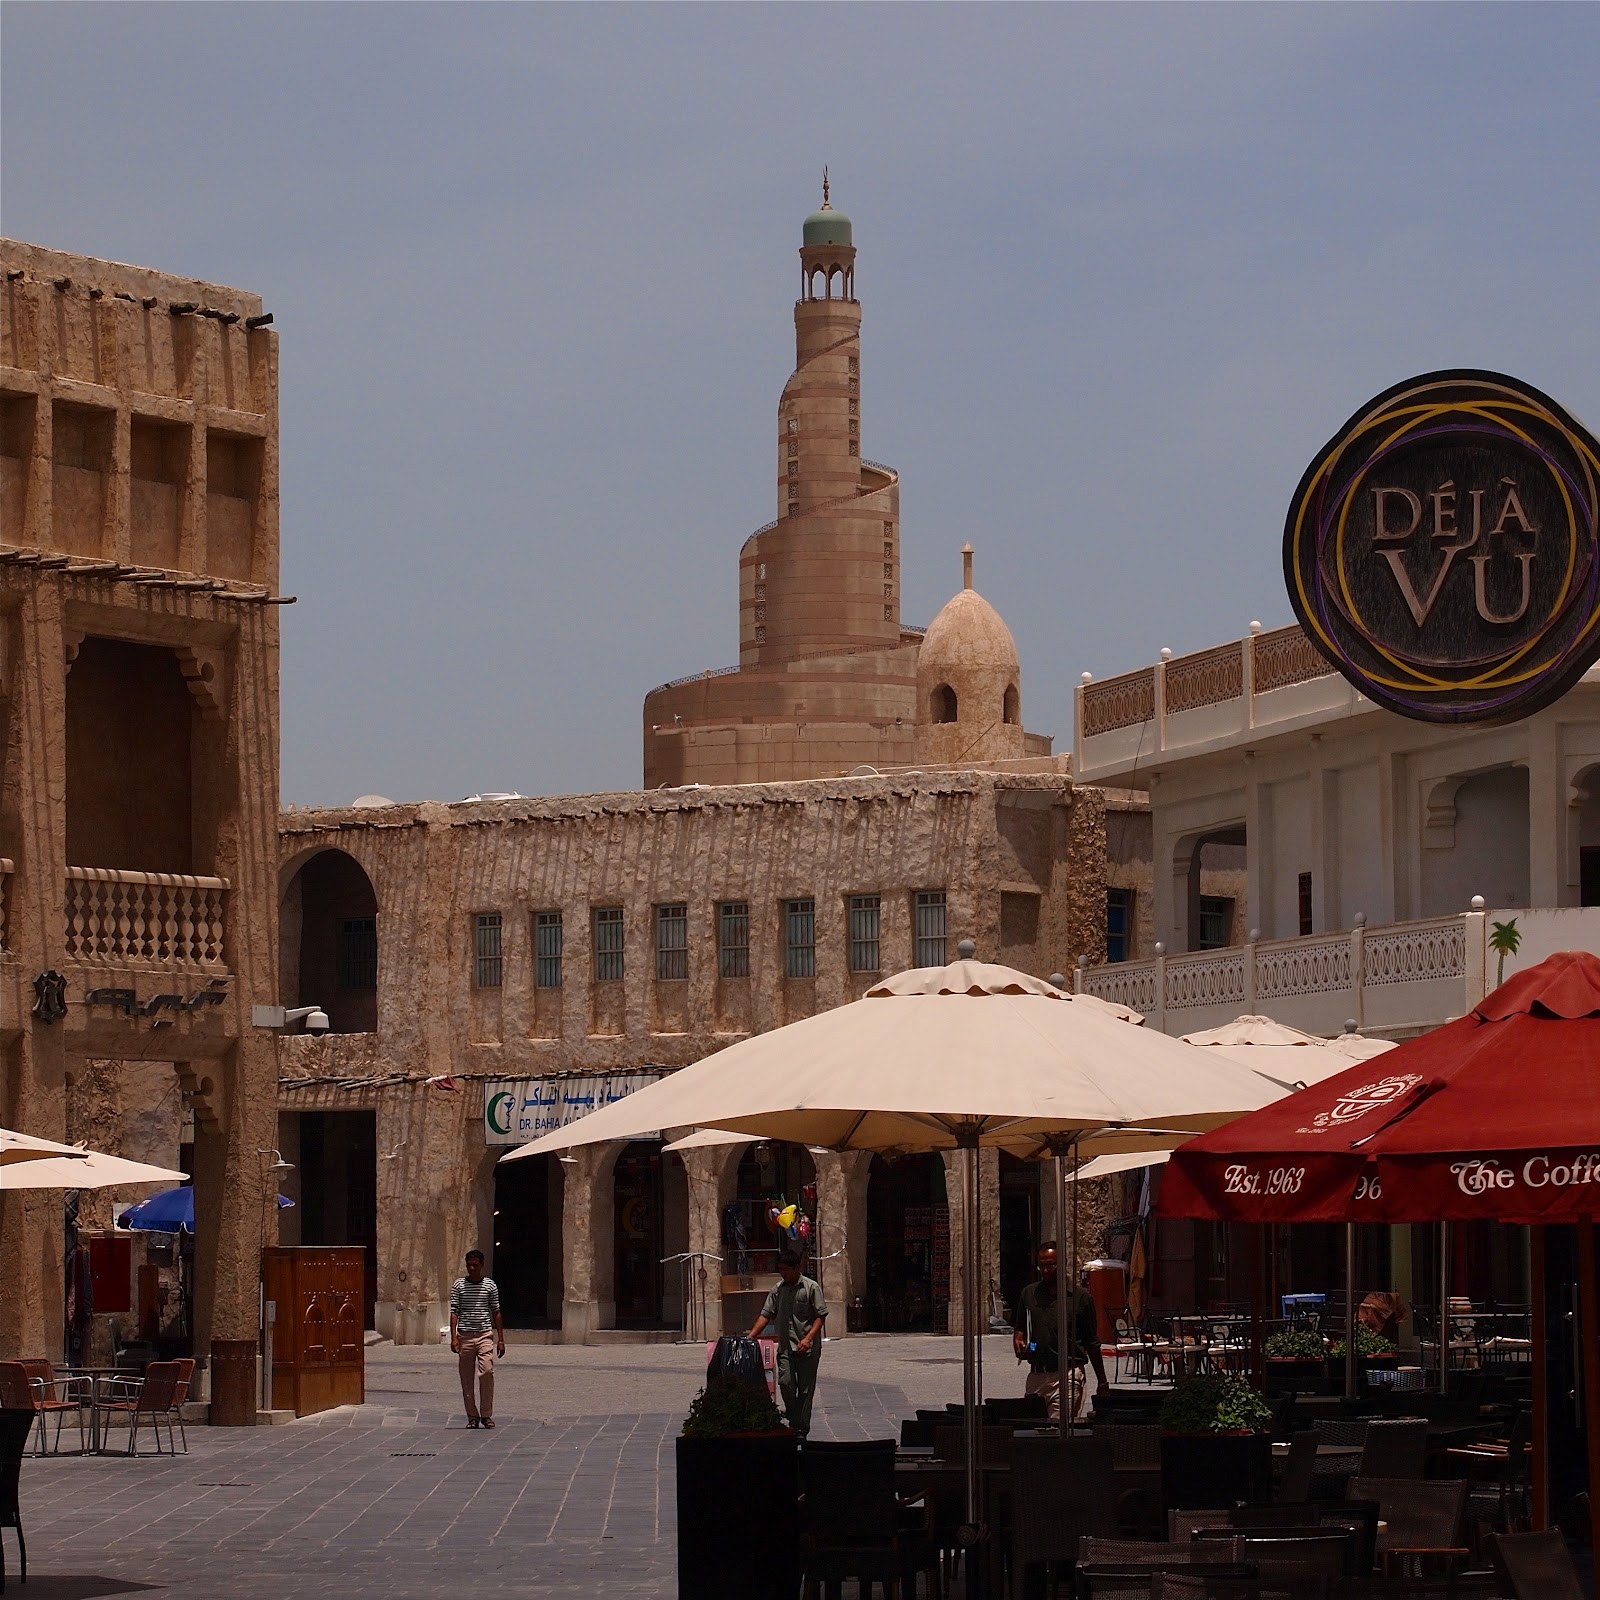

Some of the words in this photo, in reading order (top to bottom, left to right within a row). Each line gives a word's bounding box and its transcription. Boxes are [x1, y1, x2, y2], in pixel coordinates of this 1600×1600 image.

[1370, 476, 1538, 549] DÉJÀ
[1375, 548, 1536, 628] VU
[520, 1118, 534, 1130] DR.
[535, 1117, 561, 1129] BAHIA
[1224, 1164, 1262, 1195] Est.
[1263, 1166, 1306, 1195] 1963
[1450, 1159, 1515, 1195] The
